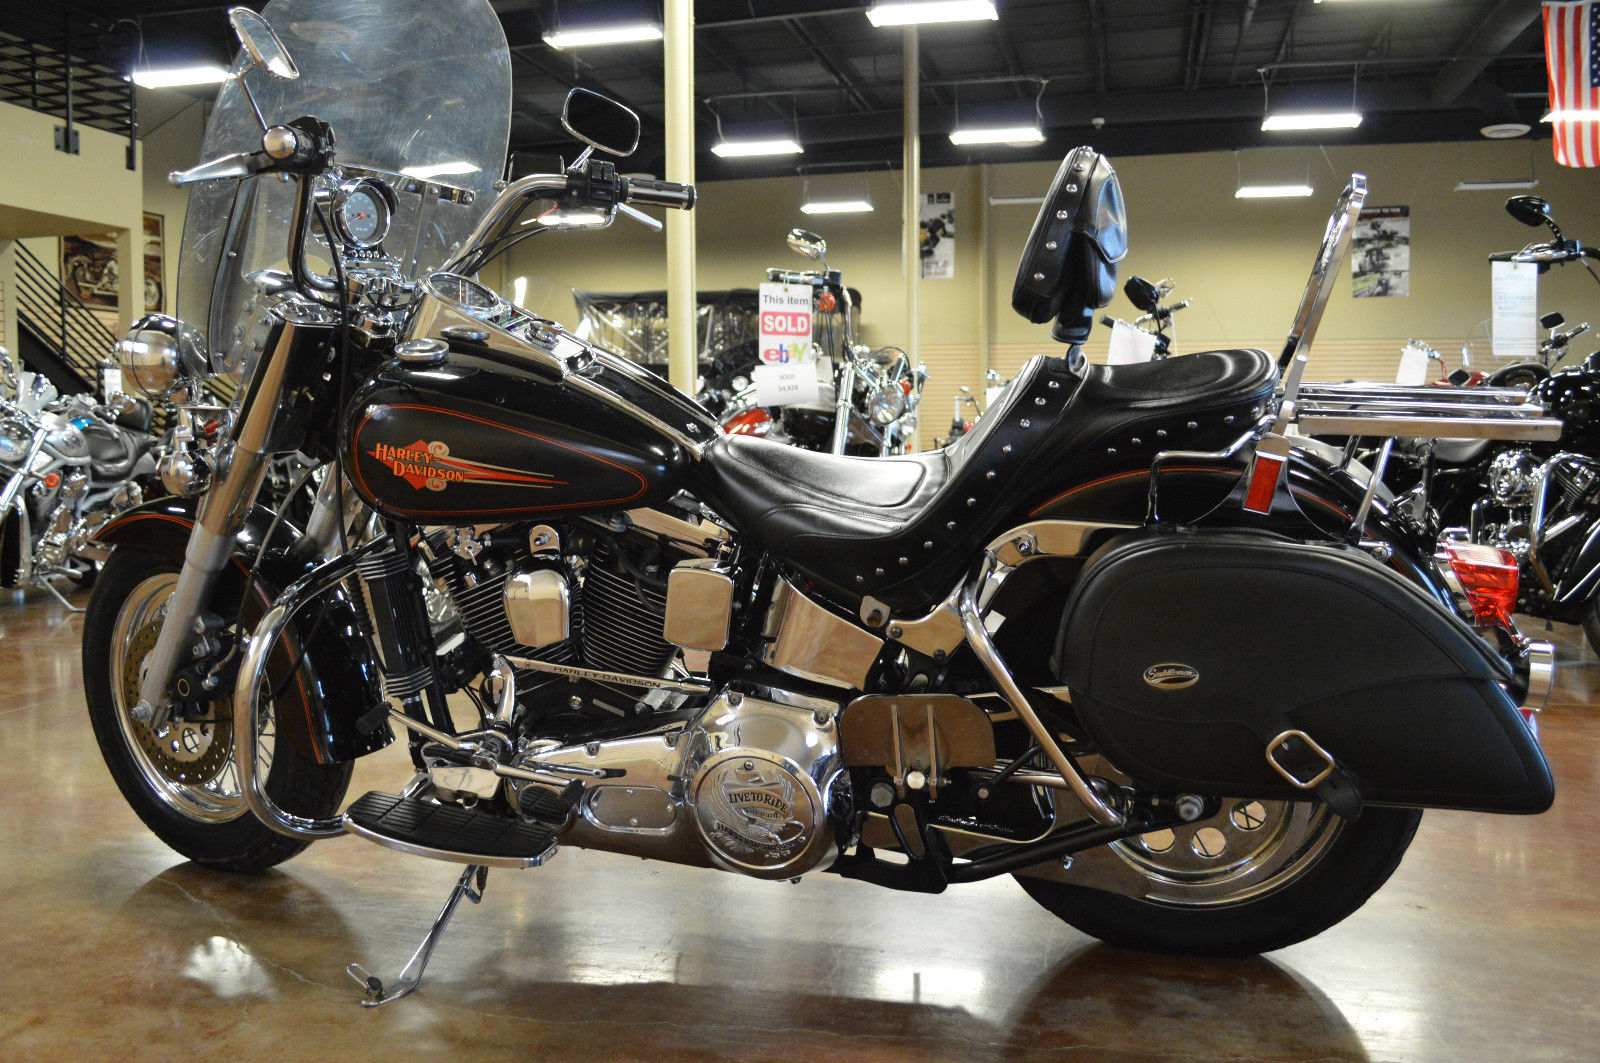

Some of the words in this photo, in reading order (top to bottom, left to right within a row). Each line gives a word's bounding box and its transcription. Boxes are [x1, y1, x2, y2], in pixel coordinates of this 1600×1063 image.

[763, 294, 784, 305] This
[787, 296, 809, 305] item
[763, 314, 808, 333] SOLD
[393, 461, 465, 482] DAVIDSON
[553, 666, 661, 689] HARLEY-DAVIDSON
[728, 793, 751, 804] LIVE
[750, 791, 763, 802] TO
[764, 794, 788, 814] RIDE
